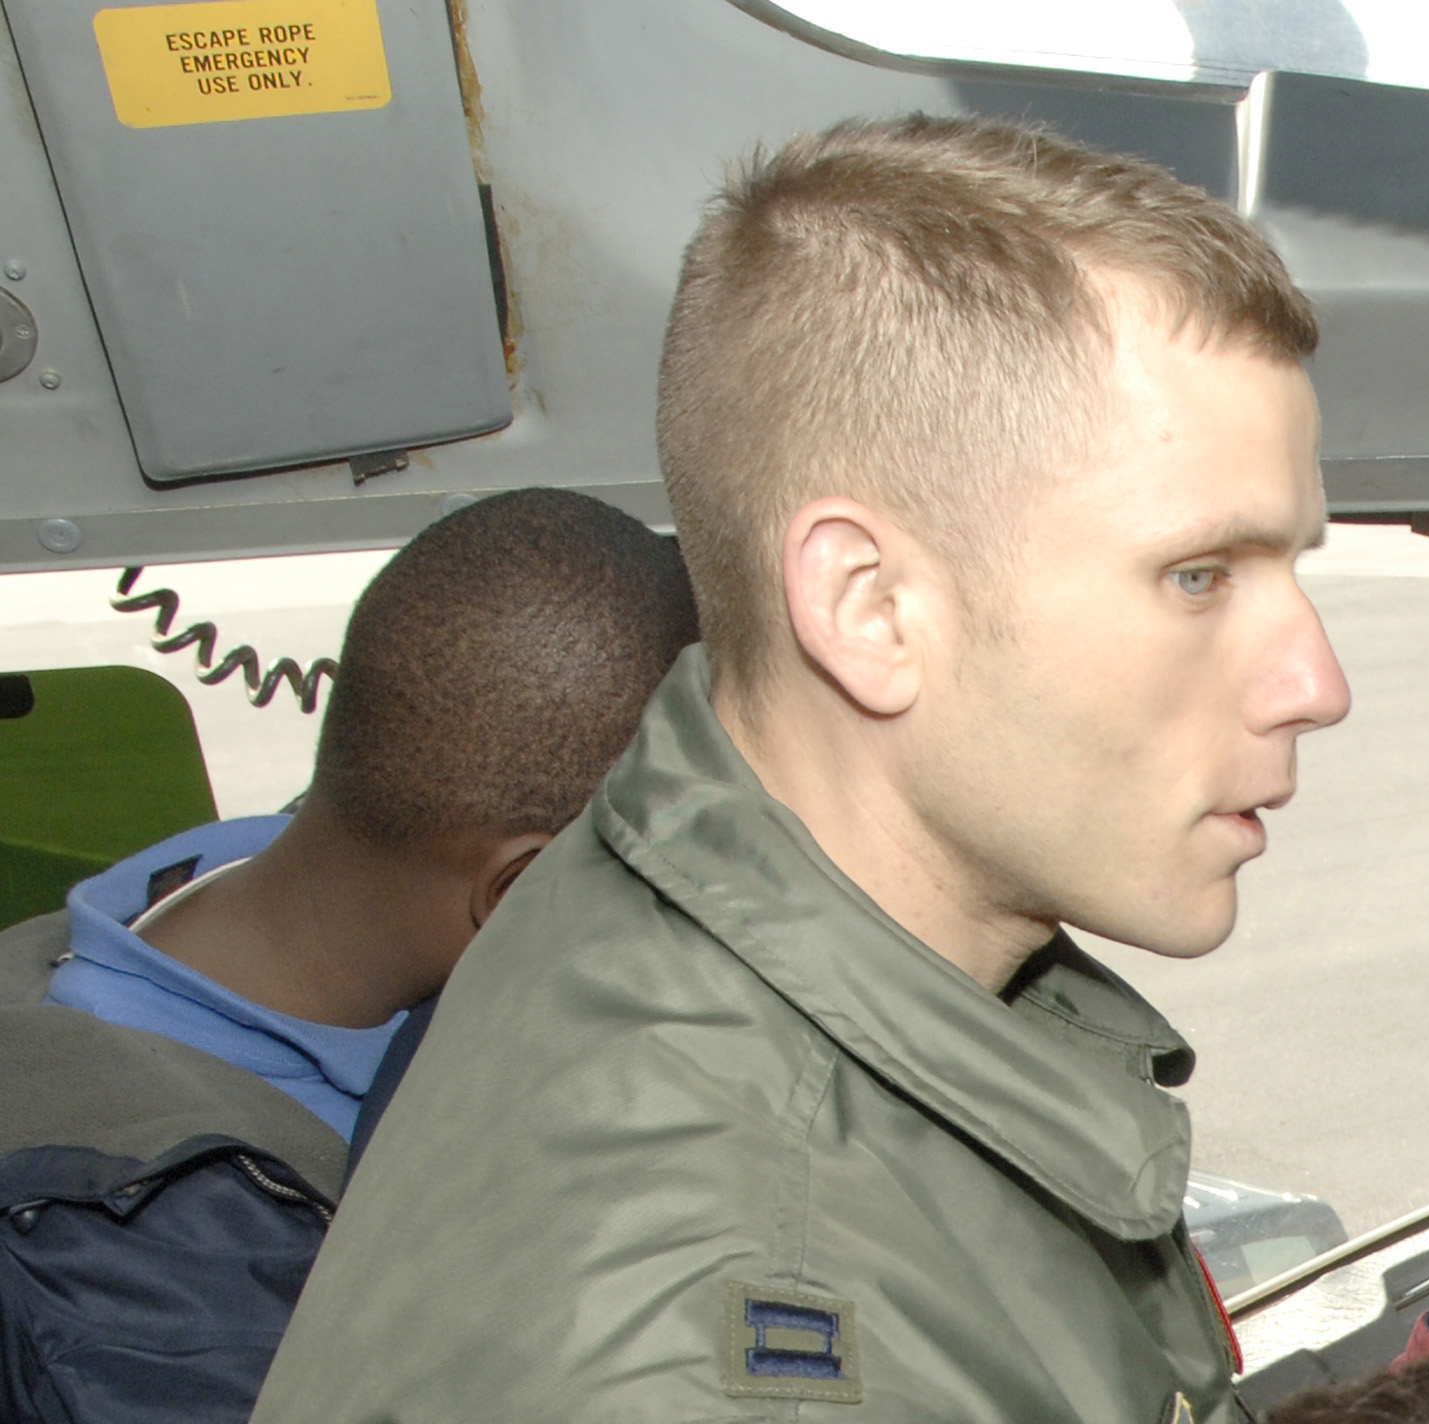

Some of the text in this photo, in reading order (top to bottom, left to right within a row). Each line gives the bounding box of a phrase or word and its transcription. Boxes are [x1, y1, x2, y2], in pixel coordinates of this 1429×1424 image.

[166, 24, 316, 51] ESCAPE ROPE
[180, 47, 310, 73] EMERGENCY
[198, 71, 313, 95] USE ONLY.
